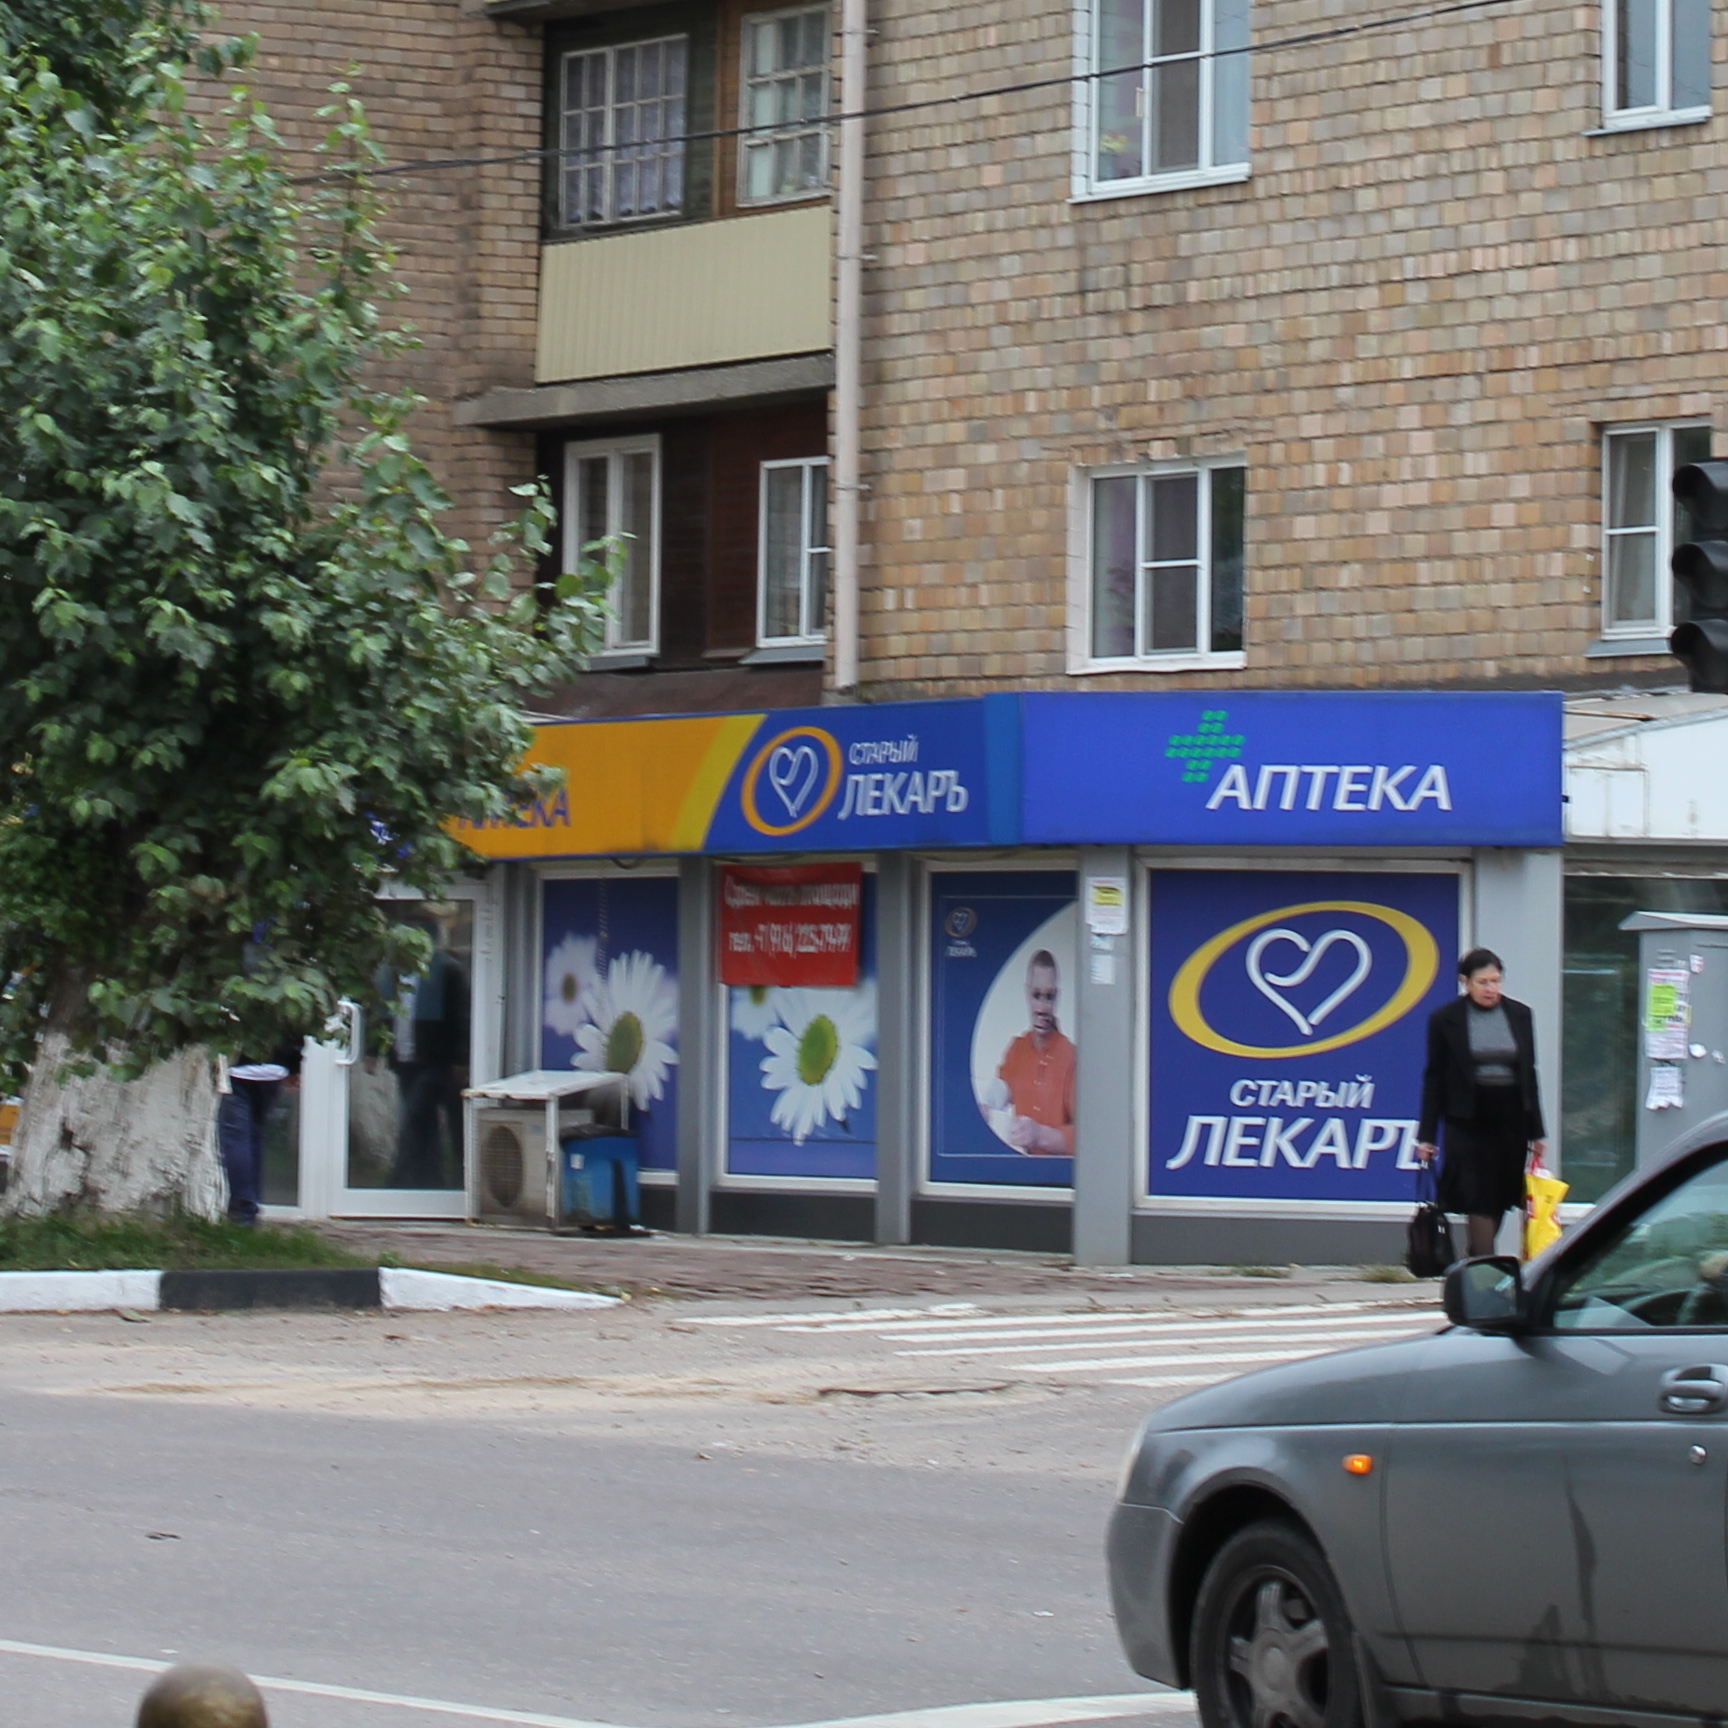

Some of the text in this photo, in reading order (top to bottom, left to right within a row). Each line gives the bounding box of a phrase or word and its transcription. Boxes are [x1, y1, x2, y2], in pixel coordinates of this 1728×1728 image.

[849, 733, 919, 765] СТАРЫЙ
[1206, 764, 1453, 811] АПТЕКА
[1229, 1074, 1375, 1109] СТАРЫЙ
